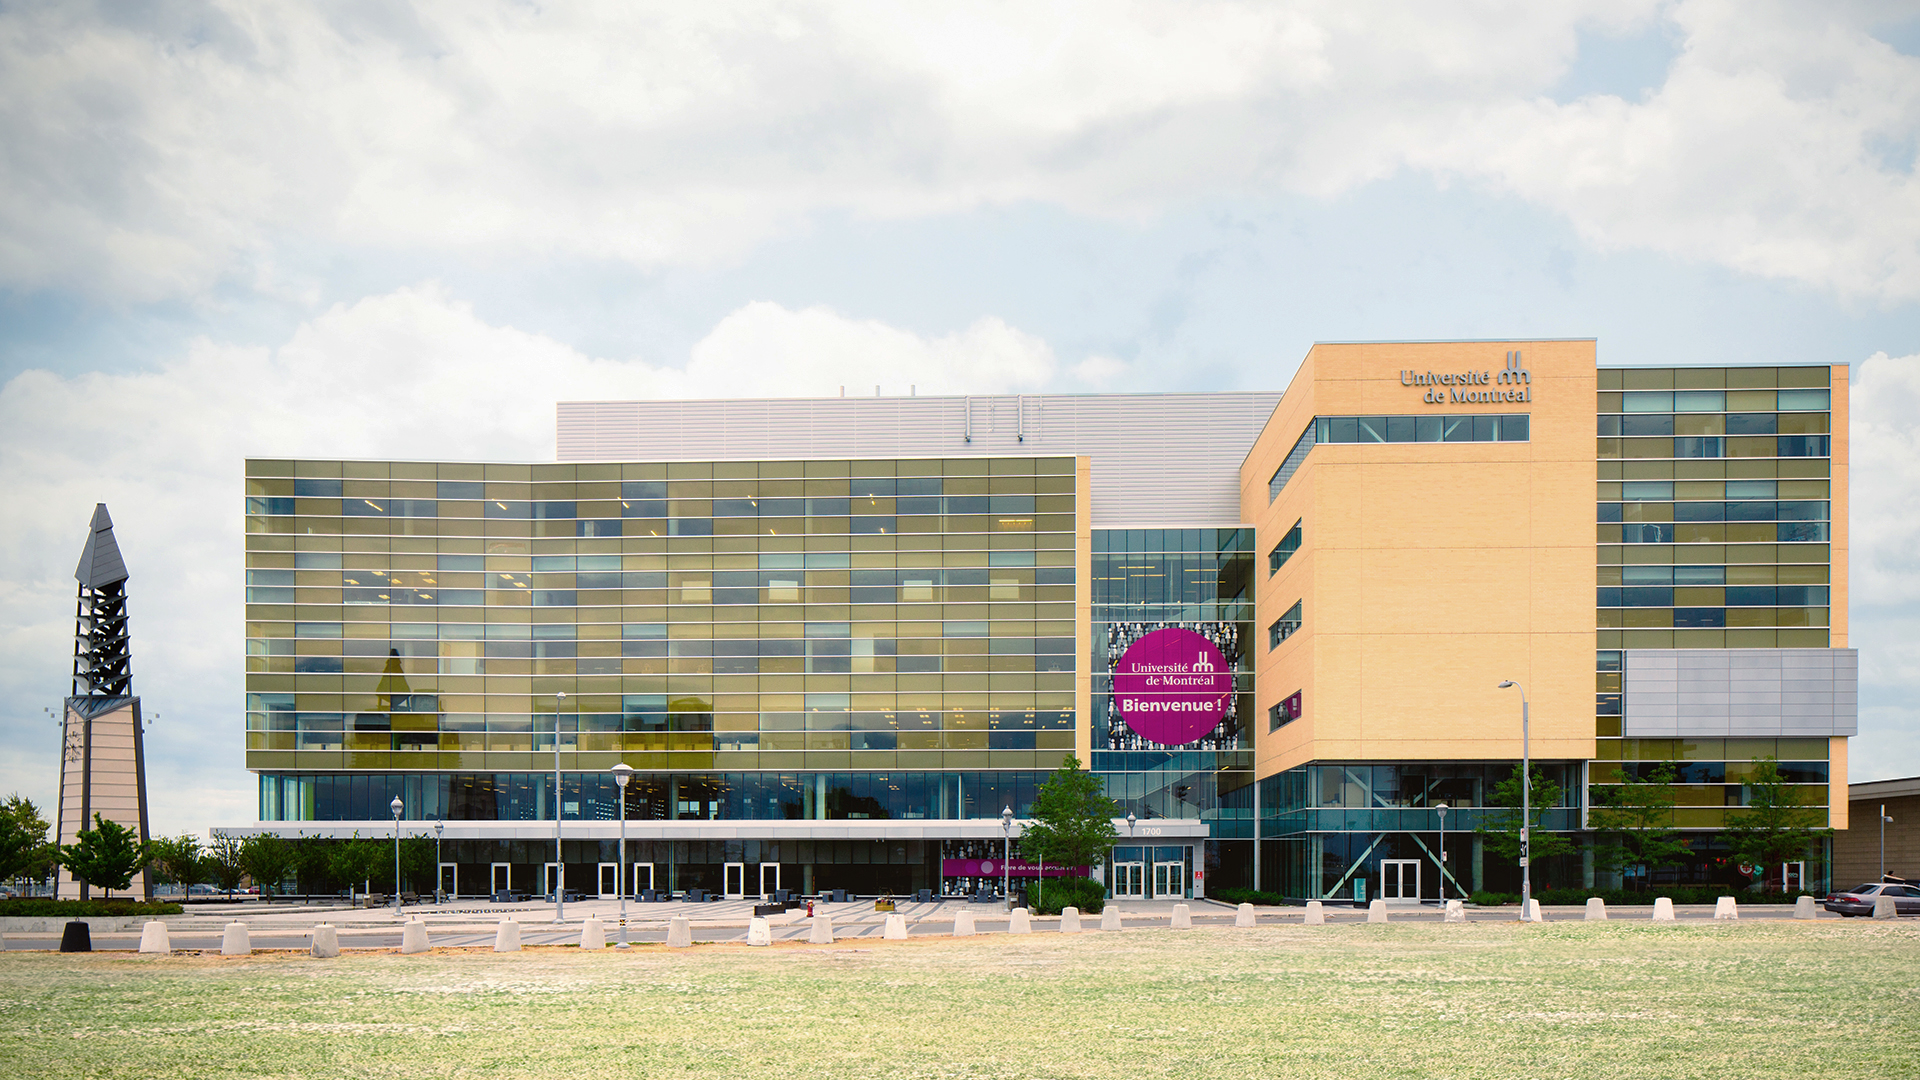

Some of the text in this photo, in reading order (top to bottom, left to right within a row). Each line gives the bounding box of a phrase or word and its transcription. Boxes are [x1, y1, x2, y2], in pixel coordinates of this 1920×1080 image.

[1400, 370, 1490, 386] Université
[1424, 387, 1532, 403] de Montréal
[1131, 663, 1189, 673] Université
[1145, 675, 1214, 686] de Montréal
[1122, 698, 1214, 712] Bienvenue
[1141, 827, 1162, 836] 1700
